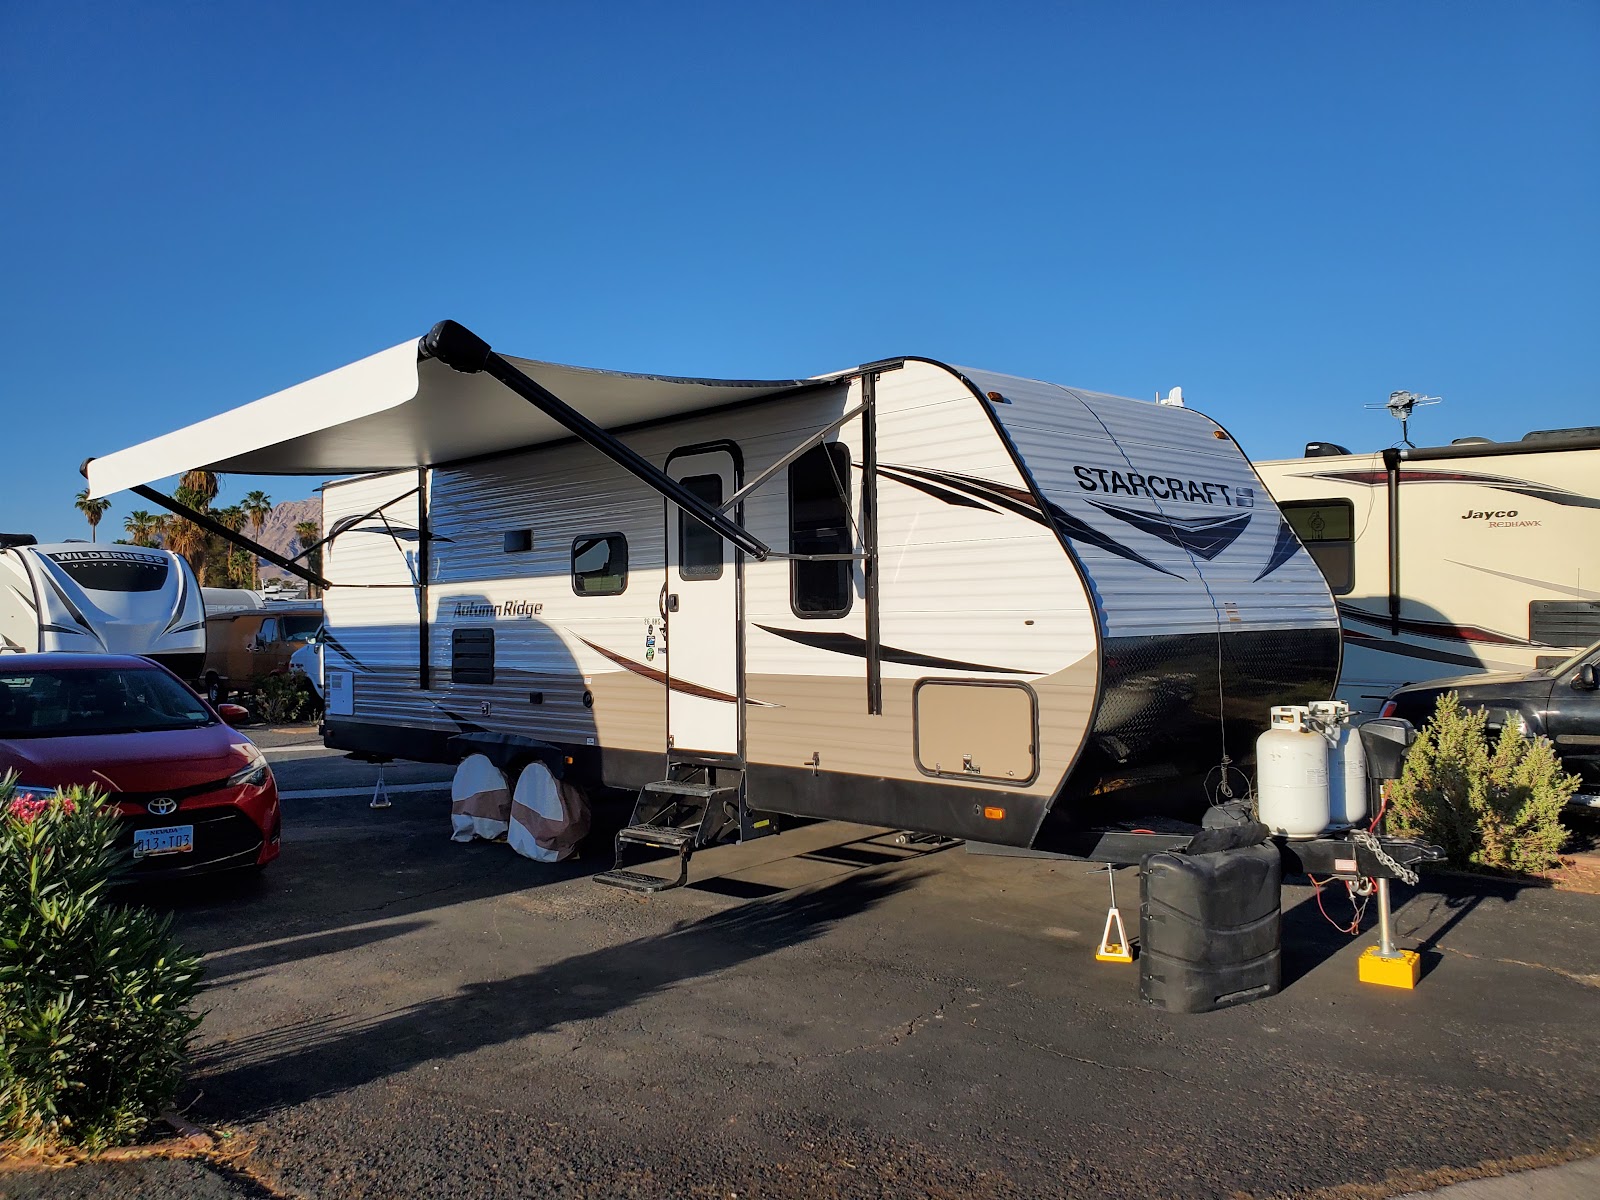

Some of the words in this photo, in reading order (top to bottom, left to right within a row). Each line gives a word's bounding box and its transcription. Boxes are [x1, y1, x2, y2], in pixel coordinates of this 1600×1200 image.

[1073, 465, 1232, 506] STARCRAFT
[1461, 509, 1519, 520] Jayco
[55, 551, 165, 564] WILDERNESS
[454, 602, 502, 618] Autumn
[503, 600, 543, 619] Ridge
[149, 827, 178, 836] NEVADA
